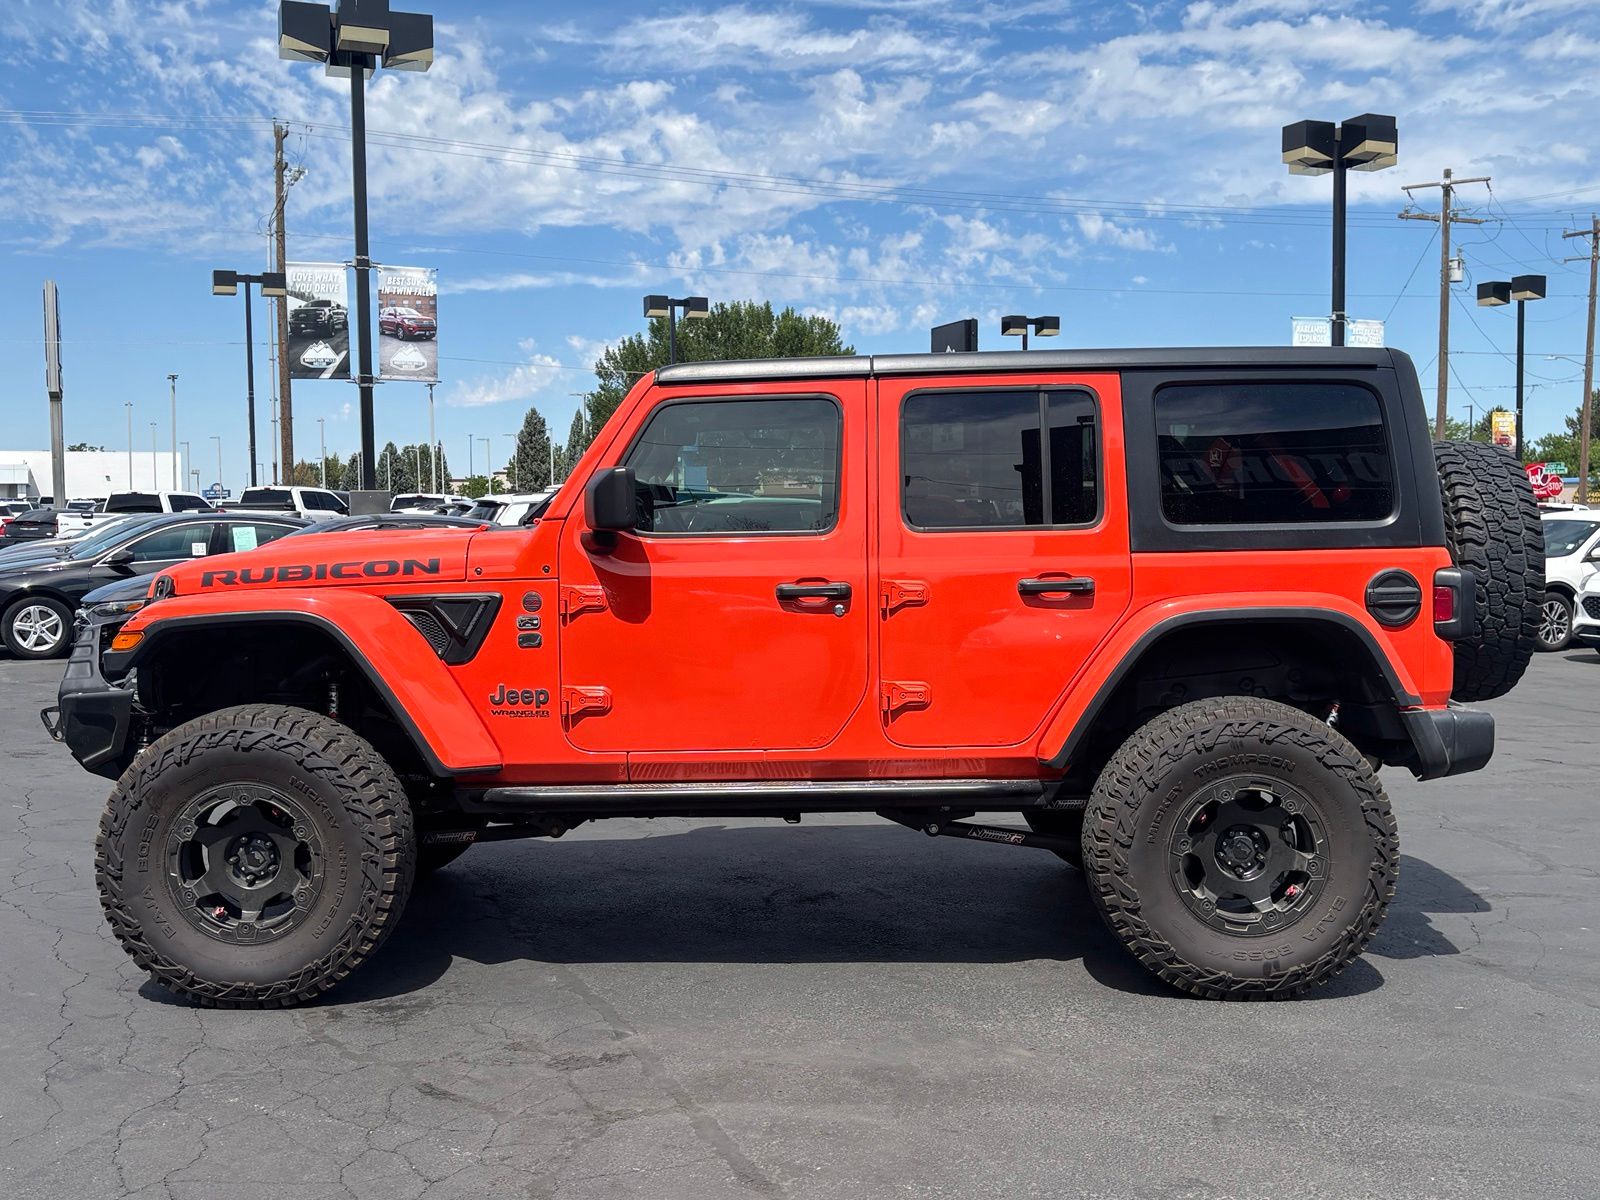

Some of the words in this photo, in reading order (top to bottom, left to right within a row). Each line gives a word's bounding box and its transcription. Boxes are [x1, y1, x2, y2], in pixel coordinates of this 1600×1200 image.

[292, 272, 313, 282] LOVE
[314, 272, 339, 283] WHAT
[295, 283, 312, 292] YOU
[314, 283, 339, 293] DRIVE
[381, 285, 390, 294] IN
[392, 286, 412, 296] TWIN
[414, 287, 434, 297] FALLS
[387, 276, 405, 286] BEST
[1548, 481, 1563, 491] STOP
[201, 558, 440, 588] RUBICON
[489, 684, 550, 709] Jeep
[288, 775, 340, 830] MICKEY
[1148, 781, 1185, 844] MICKEY
[1193, 753, 1297, 779] THOMPSON
[136, 814, 160, 873] BOSS
[311, 841, 348, 940] THOMPSON
[141, 885, 177, 940] BAJA
[1302, 895, 1347, 942] BAJA
[1232, 943, 1293, 961] BOSS
